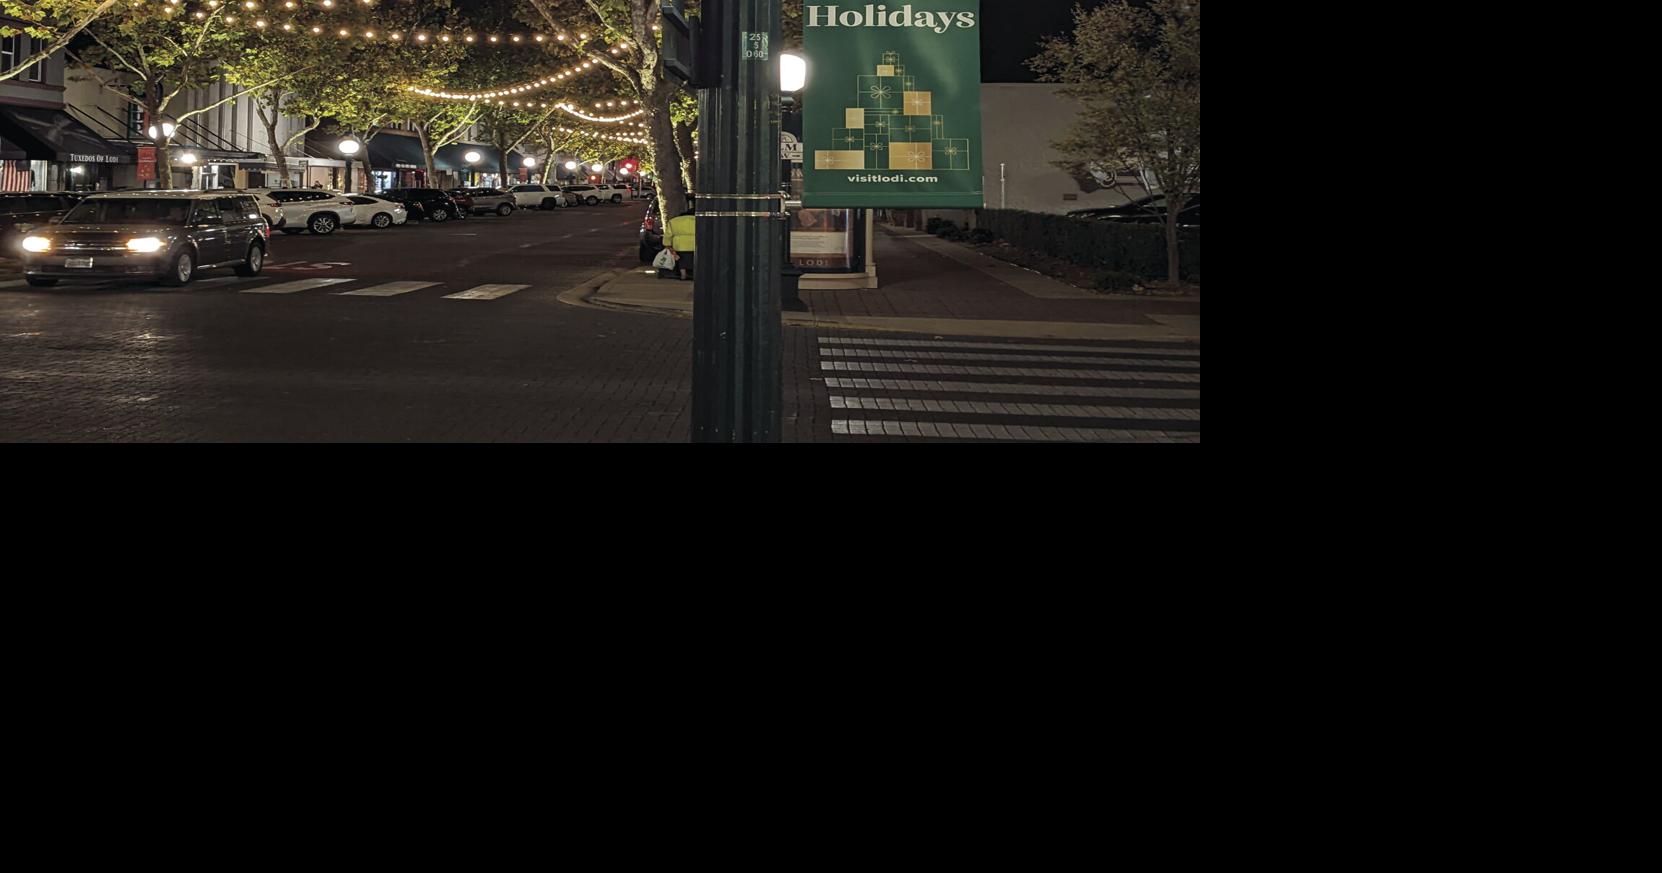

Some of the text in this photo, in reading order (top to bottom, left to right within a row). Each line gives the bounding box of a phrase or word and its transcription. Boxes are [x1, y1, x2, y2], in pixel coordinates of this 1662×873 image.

[806, 4, 975, 33] Holidays
[749, 33, 761, 41] 25
[847, 174, 938, 183] visitlodi.com
